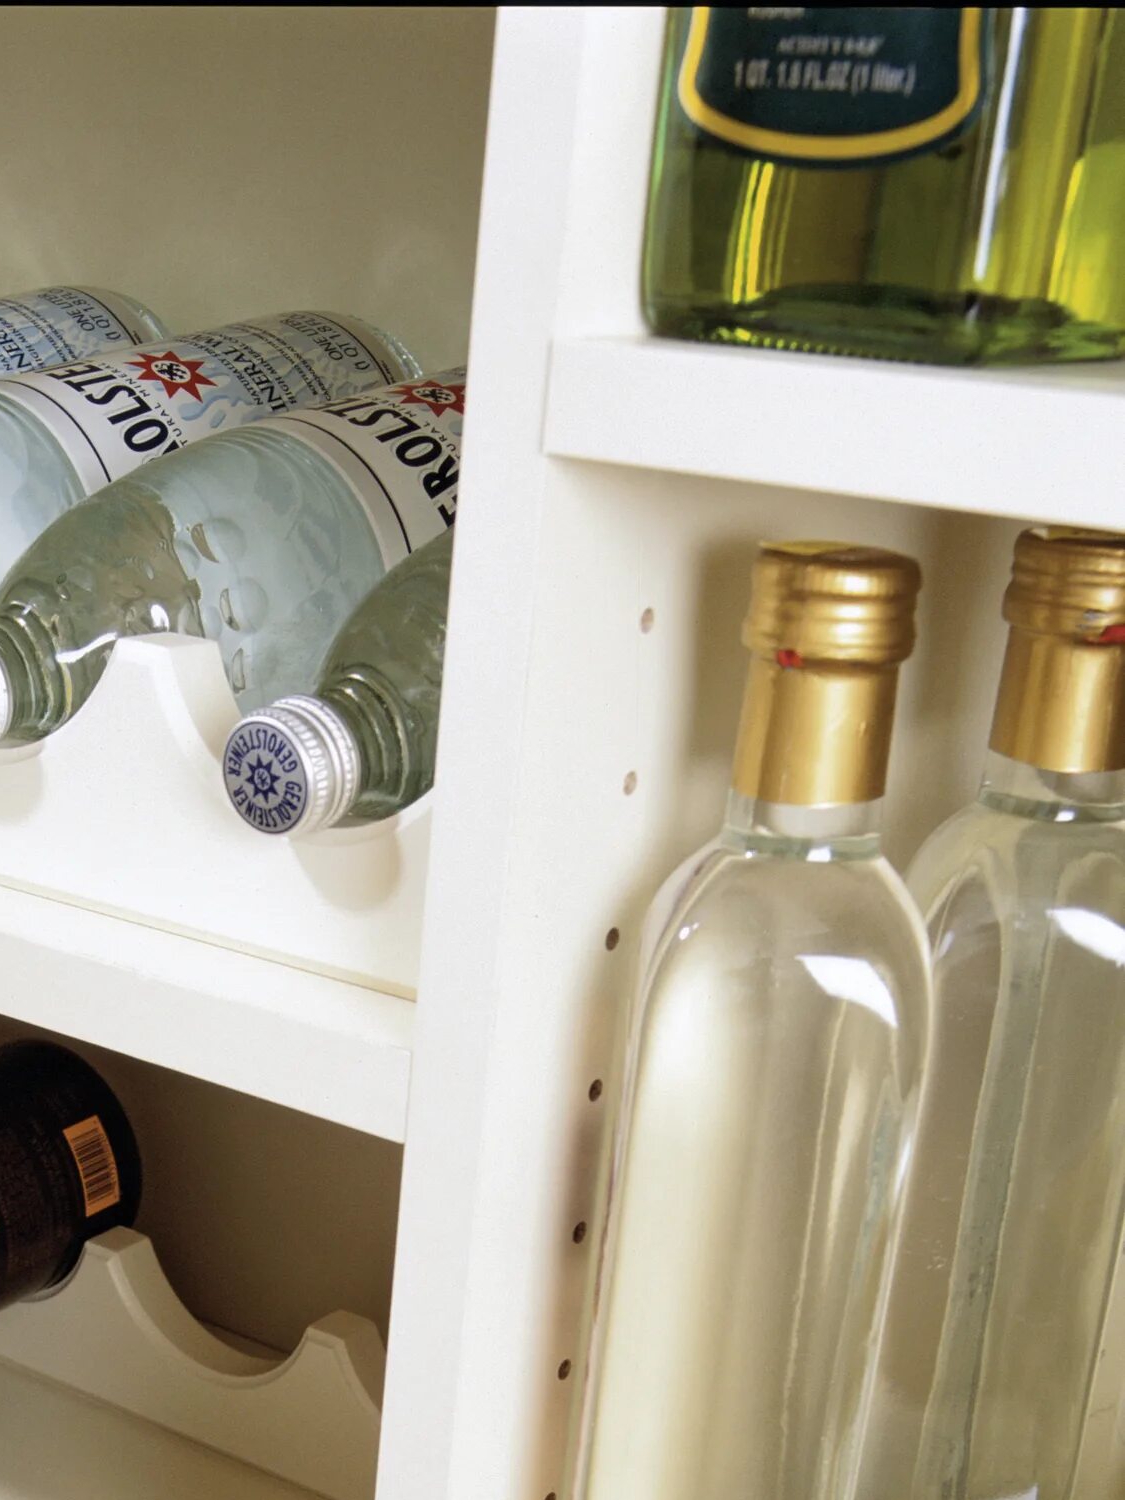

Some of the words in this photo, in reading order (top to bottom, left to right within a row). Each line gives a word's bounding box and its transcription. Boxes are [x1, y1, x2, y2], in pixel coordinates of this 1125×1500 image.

[67, 309, 96, 332] ONE
[90, 314, 111, 330] QT
[317, 325, 343, 343] 1.8
[313, 337, 345, 361] ONE
[337, 342, 360, 358] QT
[275, 375, 298, 405] HIGH
[46, 364, 180, 456] OLSTE
[227, 728, 298, 777] GEROLSTEINER
[233, 780, 303, 828] GEROLSTEINER
